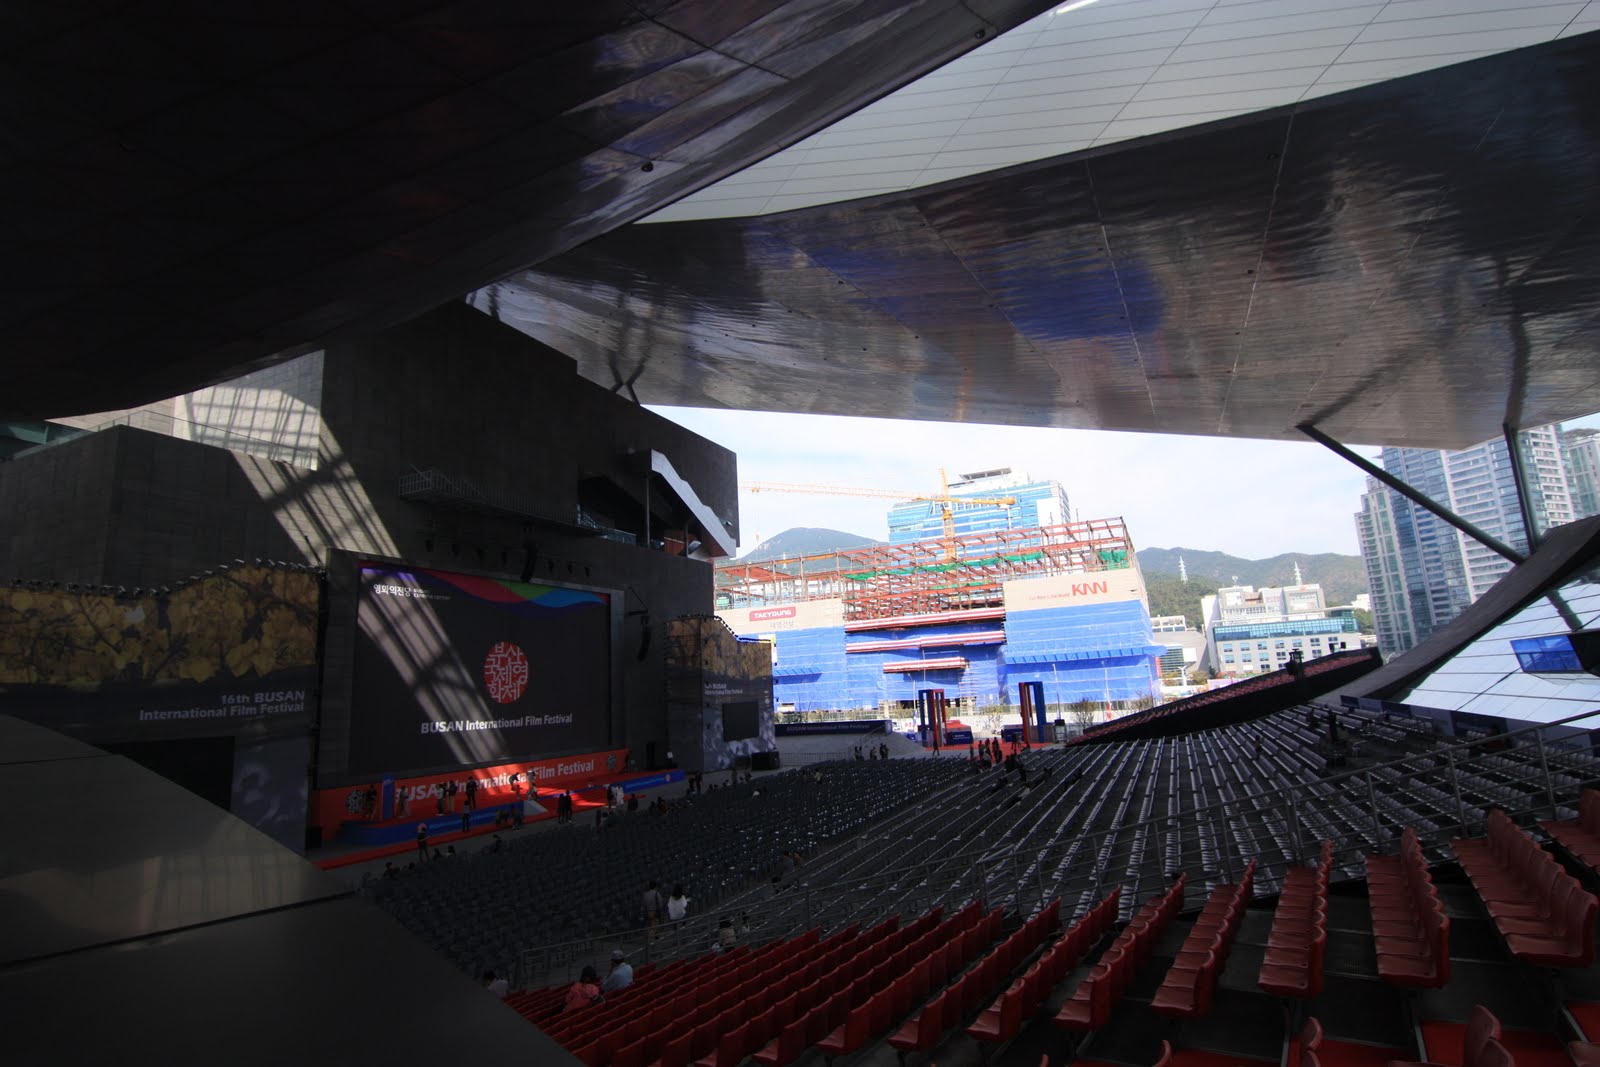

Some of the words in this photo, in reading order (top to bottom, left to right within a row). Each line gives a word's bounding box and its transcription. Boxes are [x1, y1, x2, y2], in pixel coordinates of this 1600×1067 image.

[373, 583, 411, 597] 영화의전당
[1071, 581, 1107, 596] KNN
[754, 609, 792, 618] TAEYOUNG
[221, 694, 250, 705] 16th
[254, 690, 305, 703] BUSAN
[139, 706, 227, 721] International
[230, 704, 257, 716] Film
[260, 702, 304, 714] Festival
[421, 721, 464, 734] BUSAN
[466, 717, 523, 731] International
[525, 714, 542, 726] Film
[543, 713, 573, 724] Festival
[395, 781, 450, 804] USA
[533, 766, 556, 779] Film
[557, 760, 594, 776] Festival
